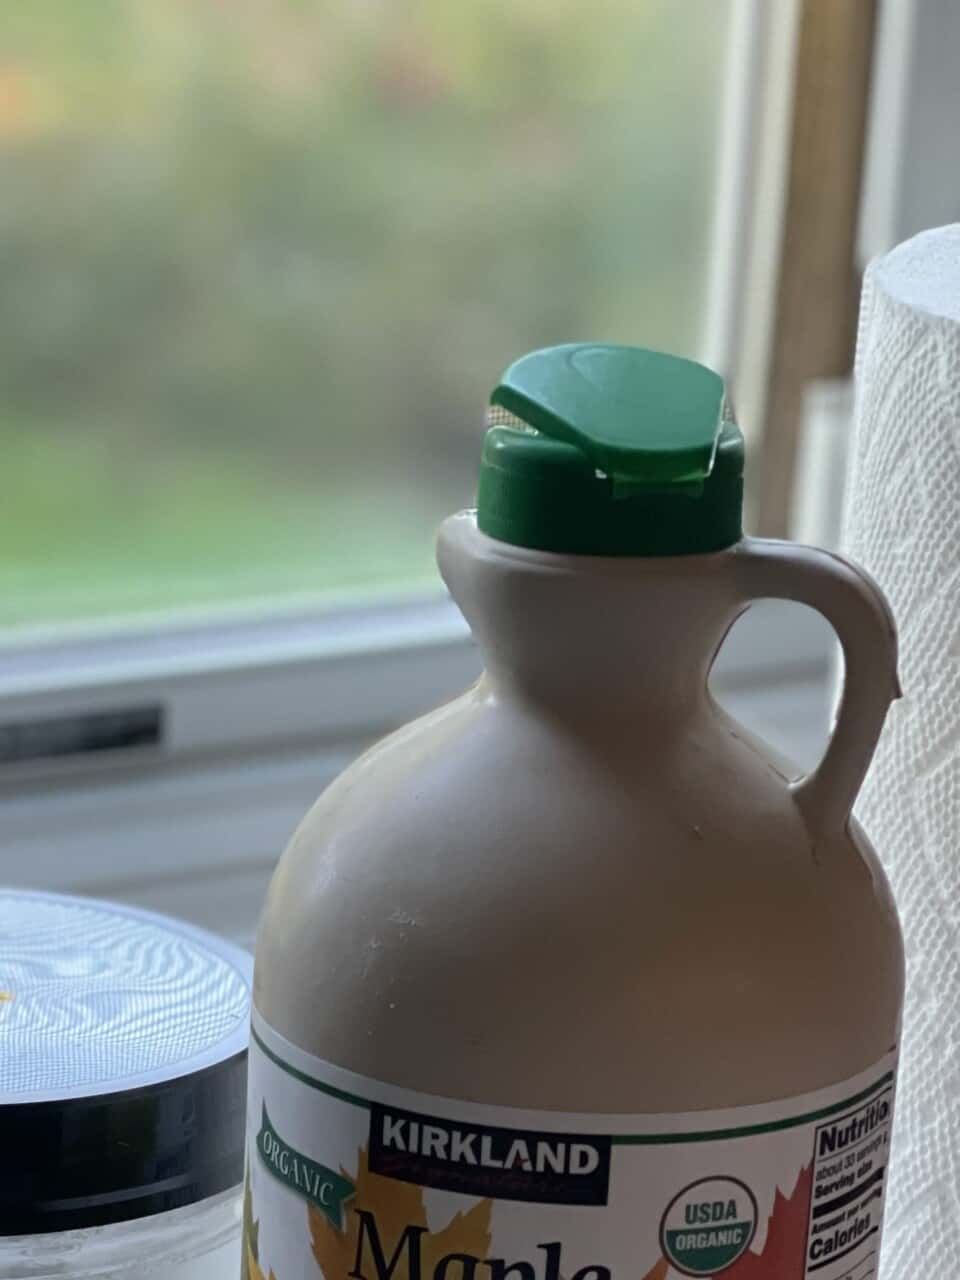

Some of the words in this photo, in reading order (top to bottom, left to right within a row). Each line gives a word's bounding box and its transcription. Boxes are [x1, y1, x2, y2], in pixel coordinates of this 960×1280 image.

[382, 1115, 600, 1176] KIRKLAND
[263, 1130, 335, 1206] ORGANIC
[815, 1171, 855, 1200] Serving
[685, 1198, 738, 1225] USDA
[675, 1227, 743, 1251] ORGANIC
[809, 1213, 871, 1261] Calories
